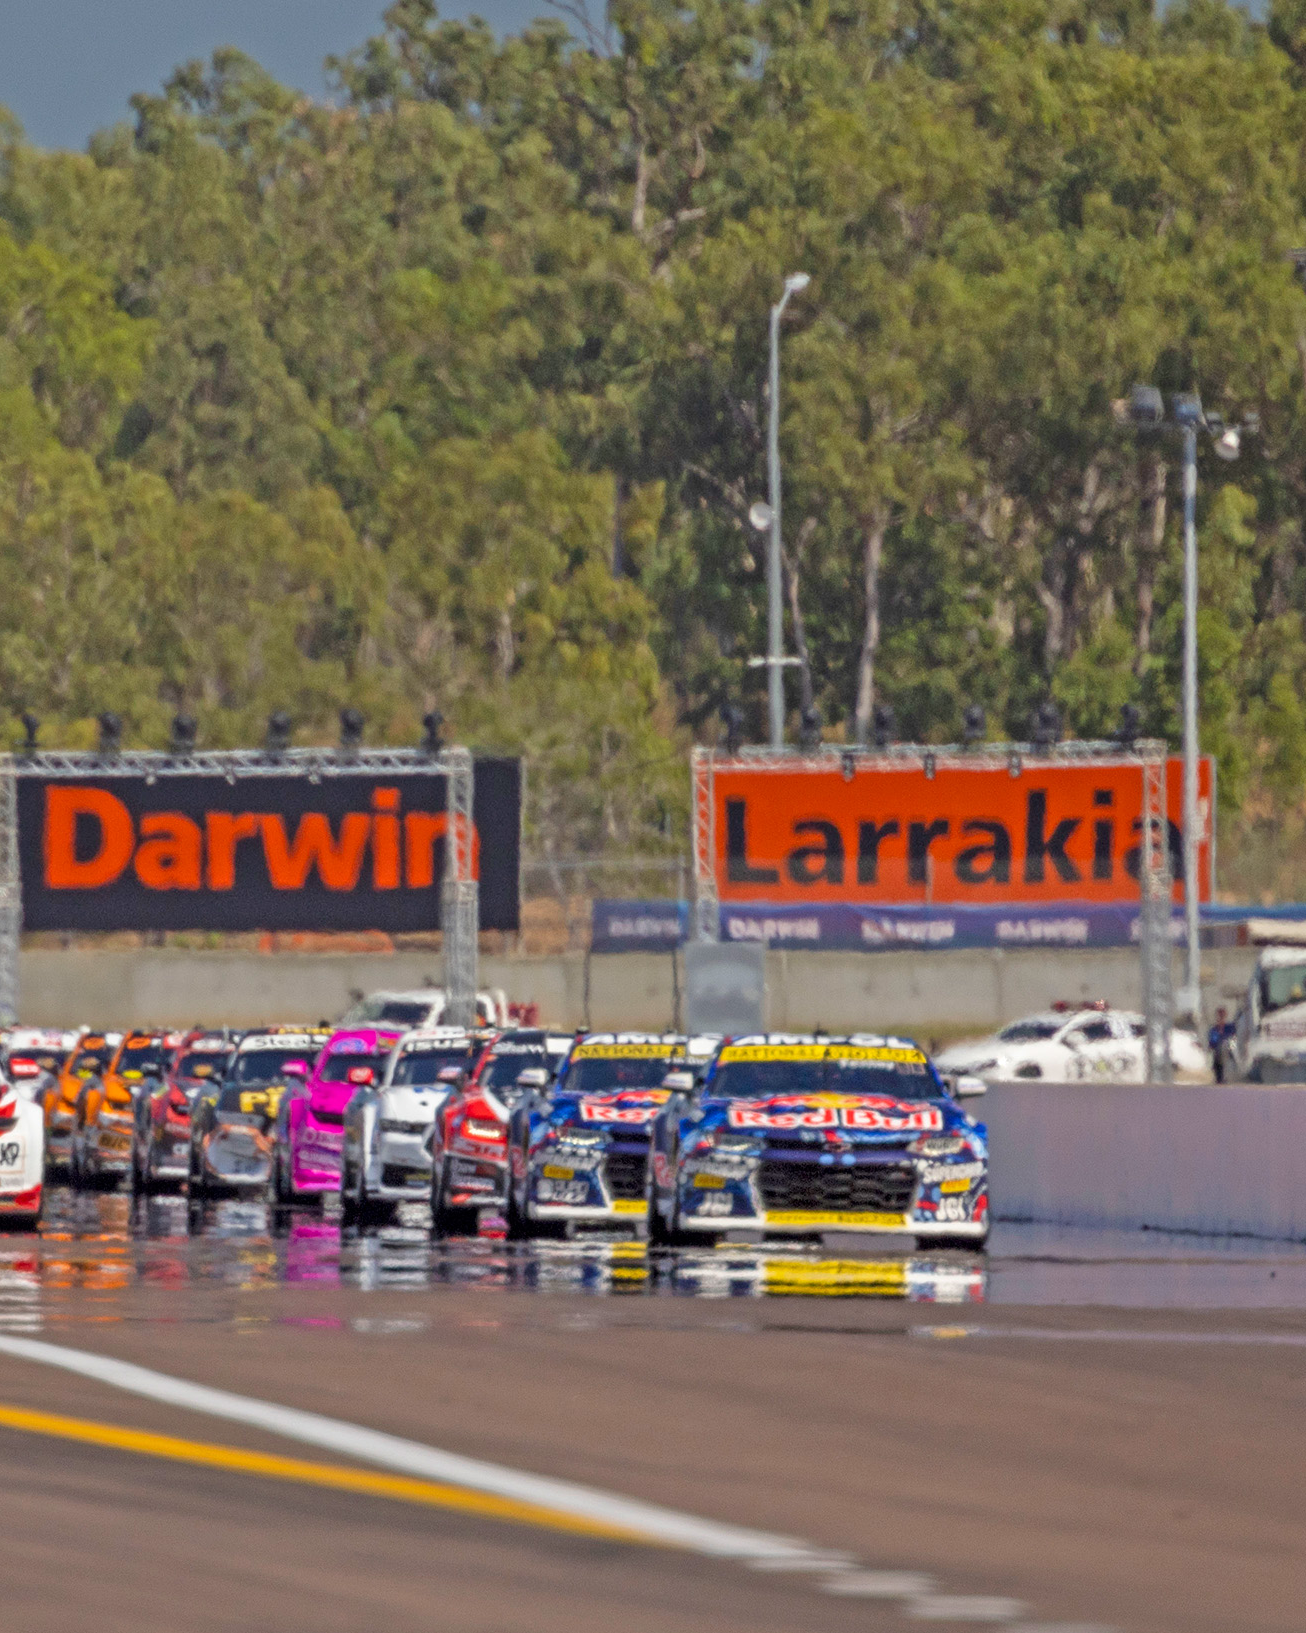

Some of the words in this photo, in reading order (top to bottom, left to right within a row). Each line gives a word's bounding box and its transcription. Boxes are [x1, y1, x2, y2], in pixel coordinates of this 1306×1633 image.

[43, 784, 481, 890] Darwin
[723, 788, 1187, 886] Larrakia
[728, 916, 820, 939] DARWIN
[405, 1039, 472, 1052] ISUZ
[728, 1108, 841, 1128] Red
[844, 1109, 944, 1131] Bull
